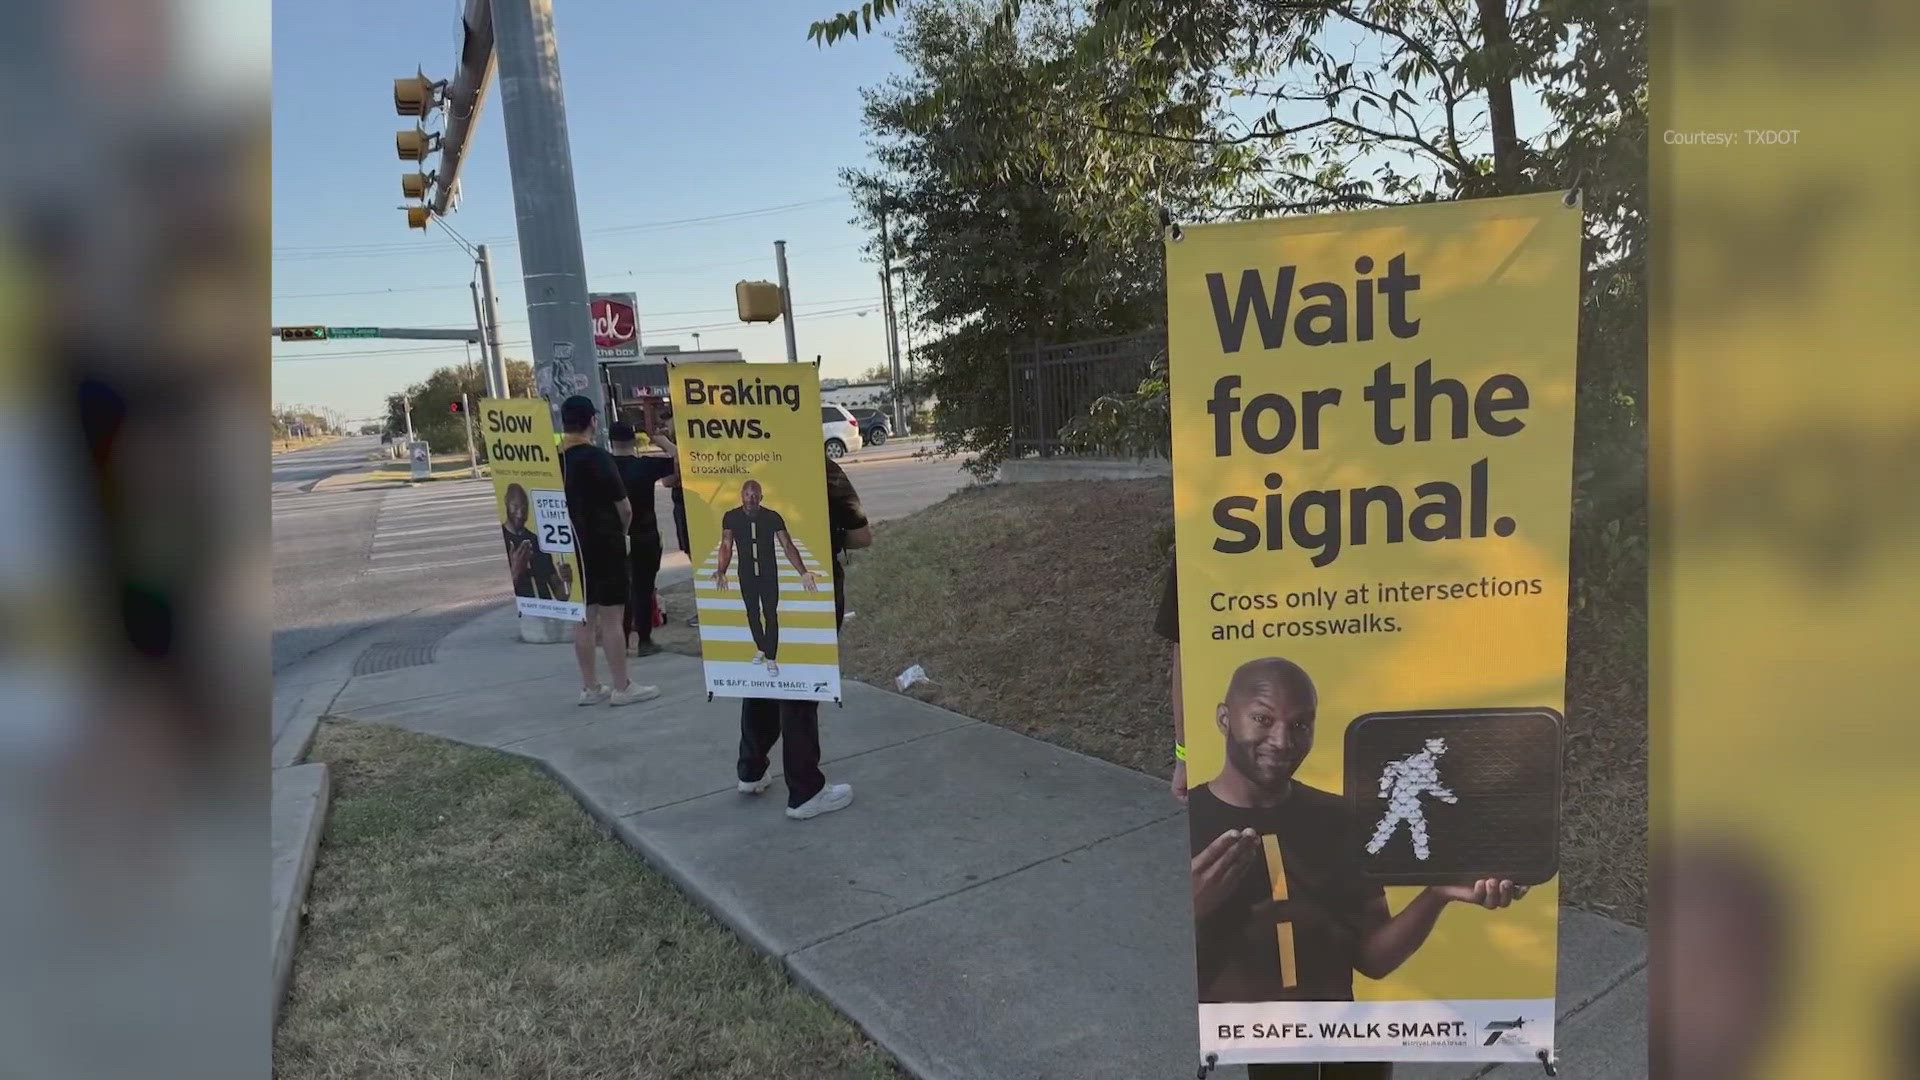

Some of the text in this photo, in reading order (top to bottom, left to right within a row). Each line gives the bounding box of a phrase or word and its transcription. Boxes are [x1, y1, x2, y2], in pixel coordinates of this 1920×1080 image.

[1205, 251, 1421, 354] Wait
[684, 377, 800, 412] Braking
[1207, 358, 1530, 458] for the
[487, 410, 532, 433] Slow
[687, 418, 771, 439] news.
[492, 440, 550, 463] down.
[689, 451, 782, 463] Stop for people in
[690, 464, 750, 474] crosswalks.
[541, 510, 566, 520] LIMIT
[1211, 456, 1516, 568] signal.
[543, 524, 571, 545] 25
[1210, 575, 1543, 612] Cross only at intersections
[1211, 613, 1402, 641] and crosswalks.
[1218, 1021, 1467, 1039] BE SAFE. WALK SMART.
